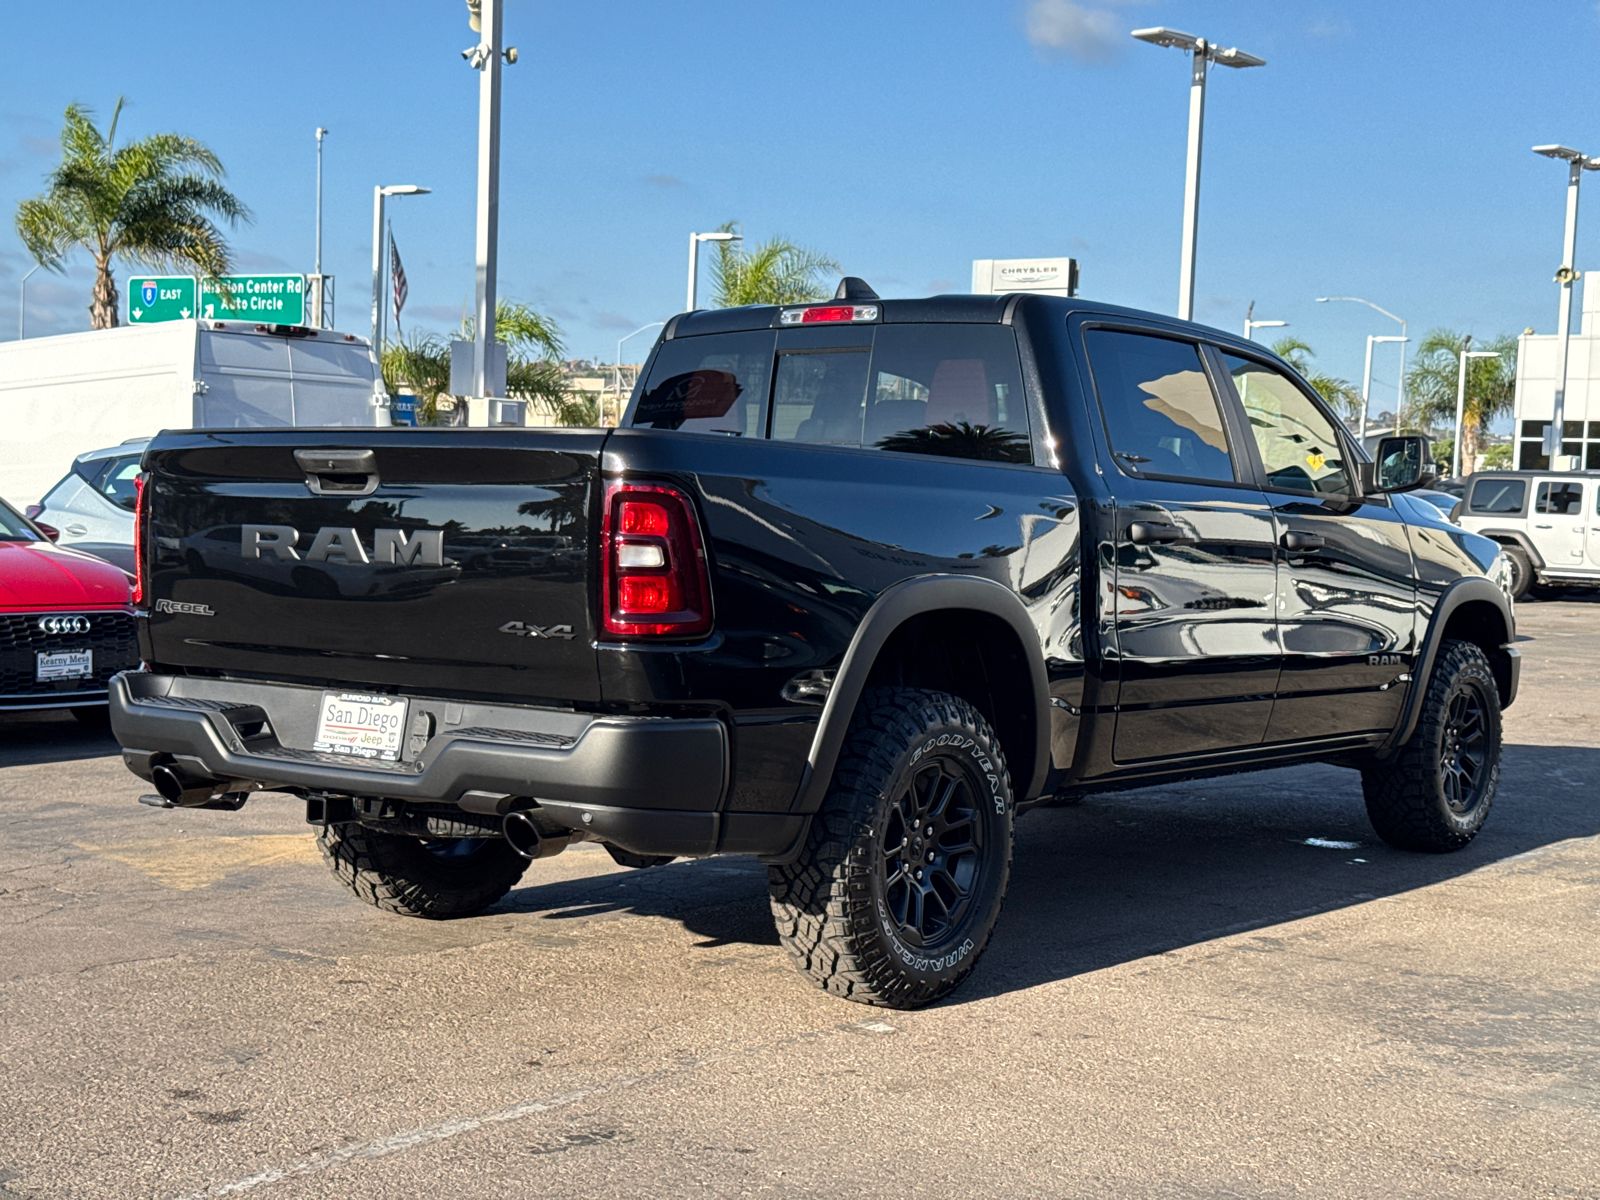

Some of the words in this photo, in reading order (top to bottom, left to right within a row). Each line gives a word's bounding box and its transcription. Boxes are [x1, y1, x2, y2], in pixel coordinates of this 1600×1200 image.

[1001, 266, 1058, 274] CHRYSLER
[246, 279, 284, 294] Center
[287, 279, 302, 294] Rd
[147, 289, 152, 301] 8
[160, 289, 181, 300] EAST
[250, 296, 283, 310] Circle
[241, 524, 444, 566] RAM
[155, 598, 216, 616] REBEL
[498, 621, 577, 640] 4x4
[40, 657, 68, 666] Kearny
[69, 655, 90, 663] Mesa
[1367, 655, 1402, 666] RAM
[341, 693, 371, 703] SUNROAD
[326, 704, 353, 724] San
[357, 706, 398, 734] Diego
[360, 732, 383, 746] Jeep
[334, 744, 350, 754] San
[351, 745, 377, 758] Diego
[909, 733, 1006, 816] GOODYEAR
[877, 898, 975, 972] WRANGLER
